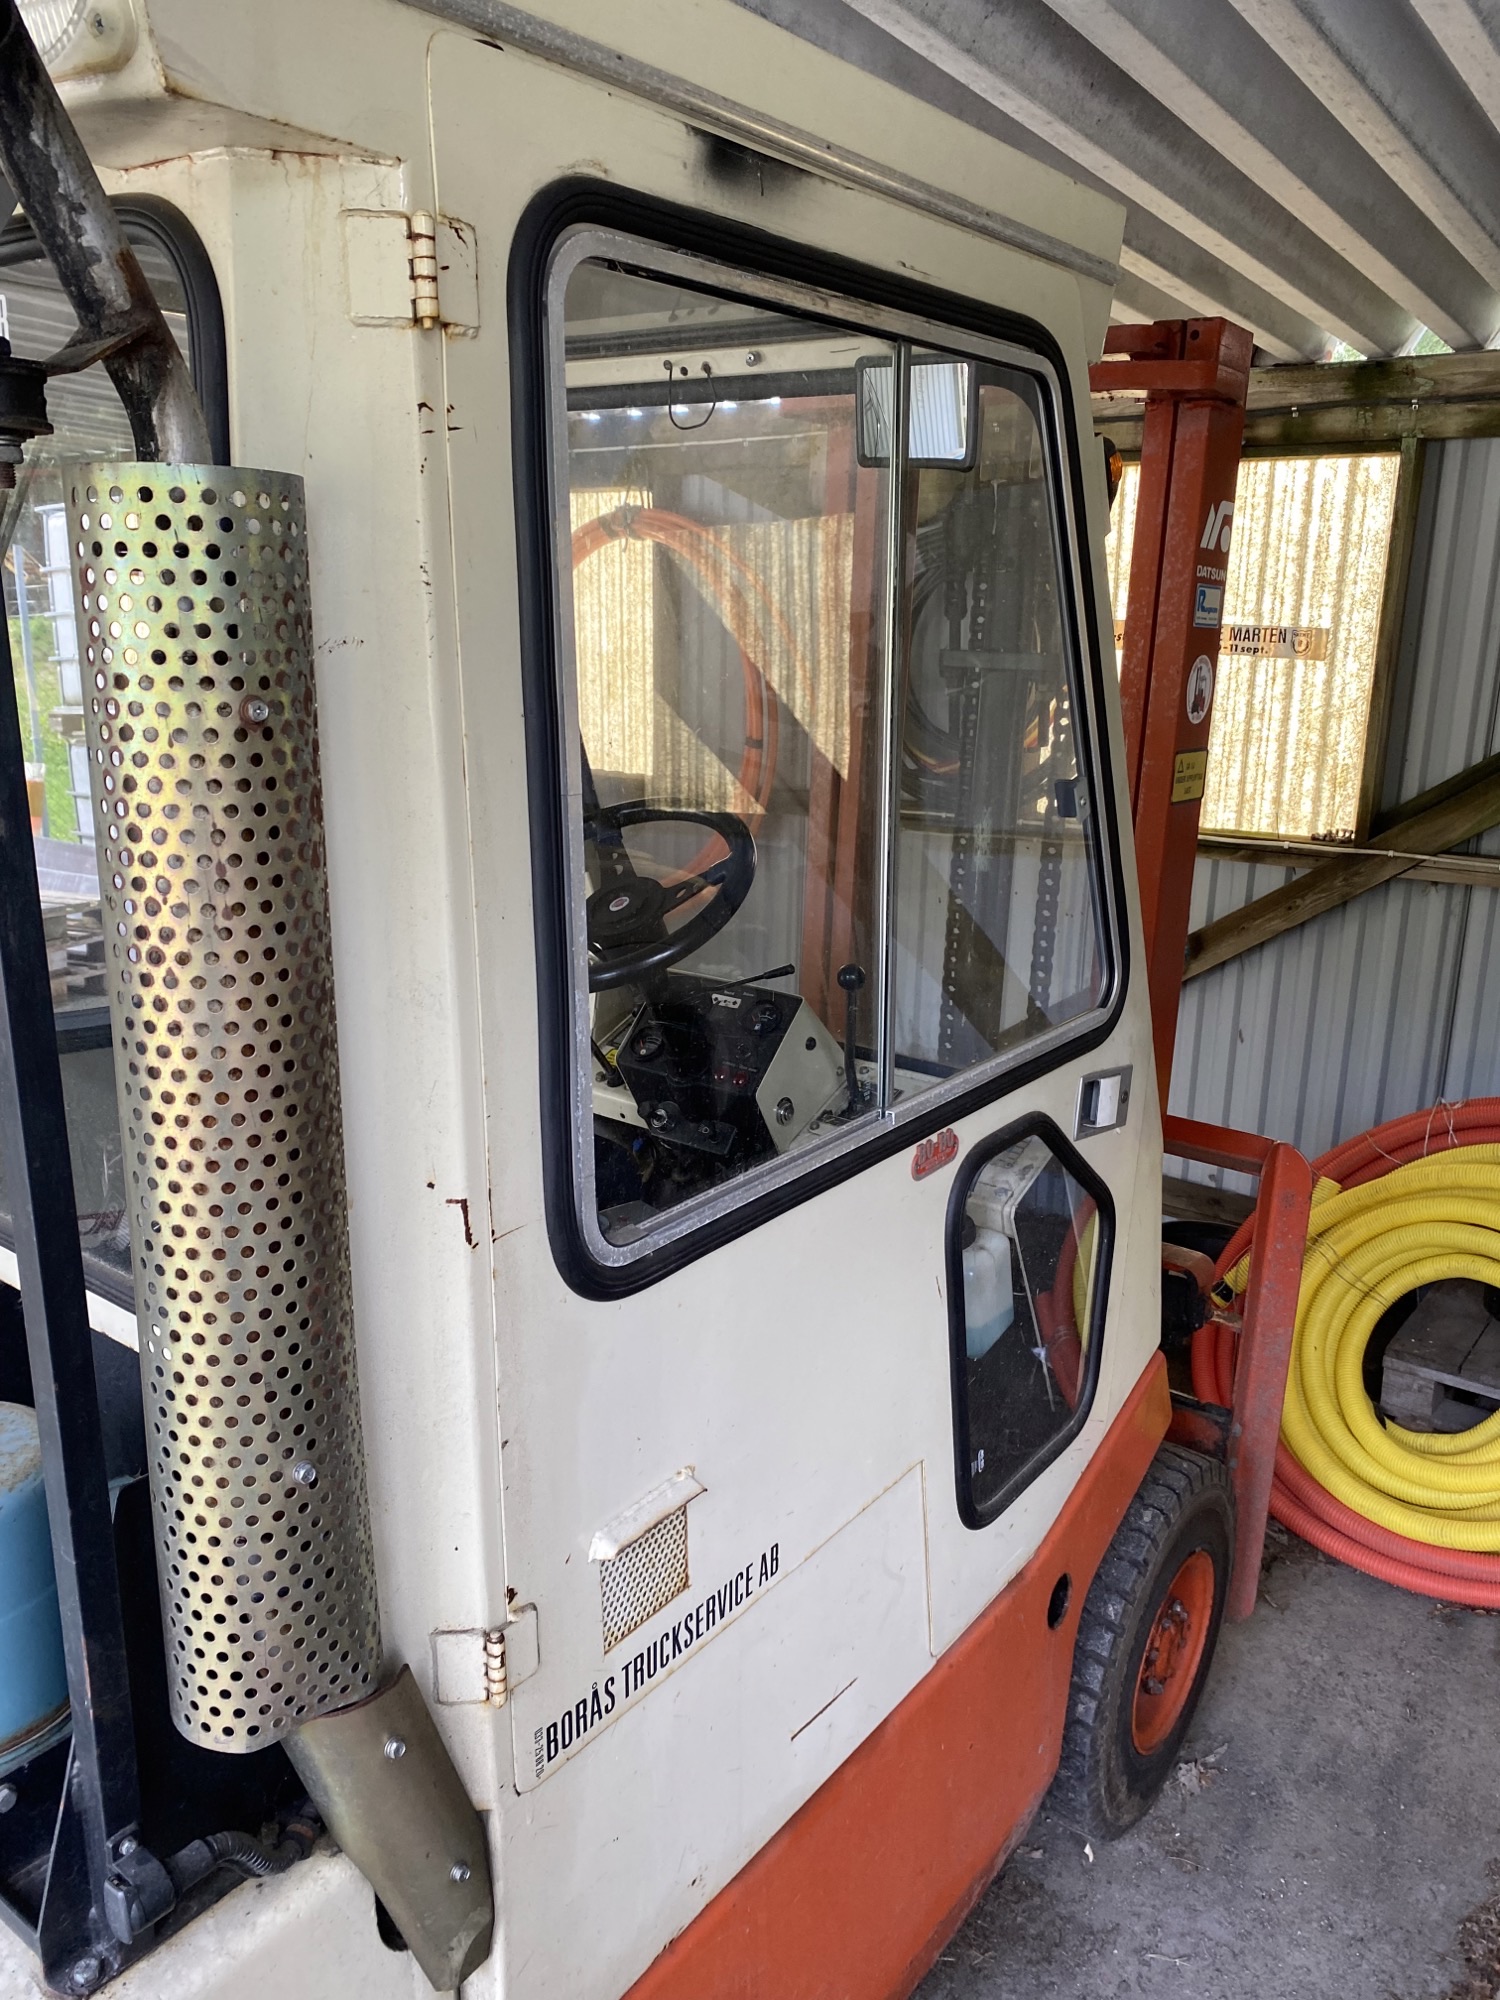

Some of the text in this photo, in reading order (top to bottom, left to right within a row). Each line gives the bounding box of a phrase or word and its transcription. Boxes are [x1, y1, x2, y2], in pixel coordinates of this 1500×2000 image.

[1197, 565, 1226, 581] DATSUN
[1229, 626, 1287, 644] MARTEN
[1240, 645, 1269, 655] sept.
[546, 1543, 779, 1763] BORÅS TRUCKSERVICE AB
